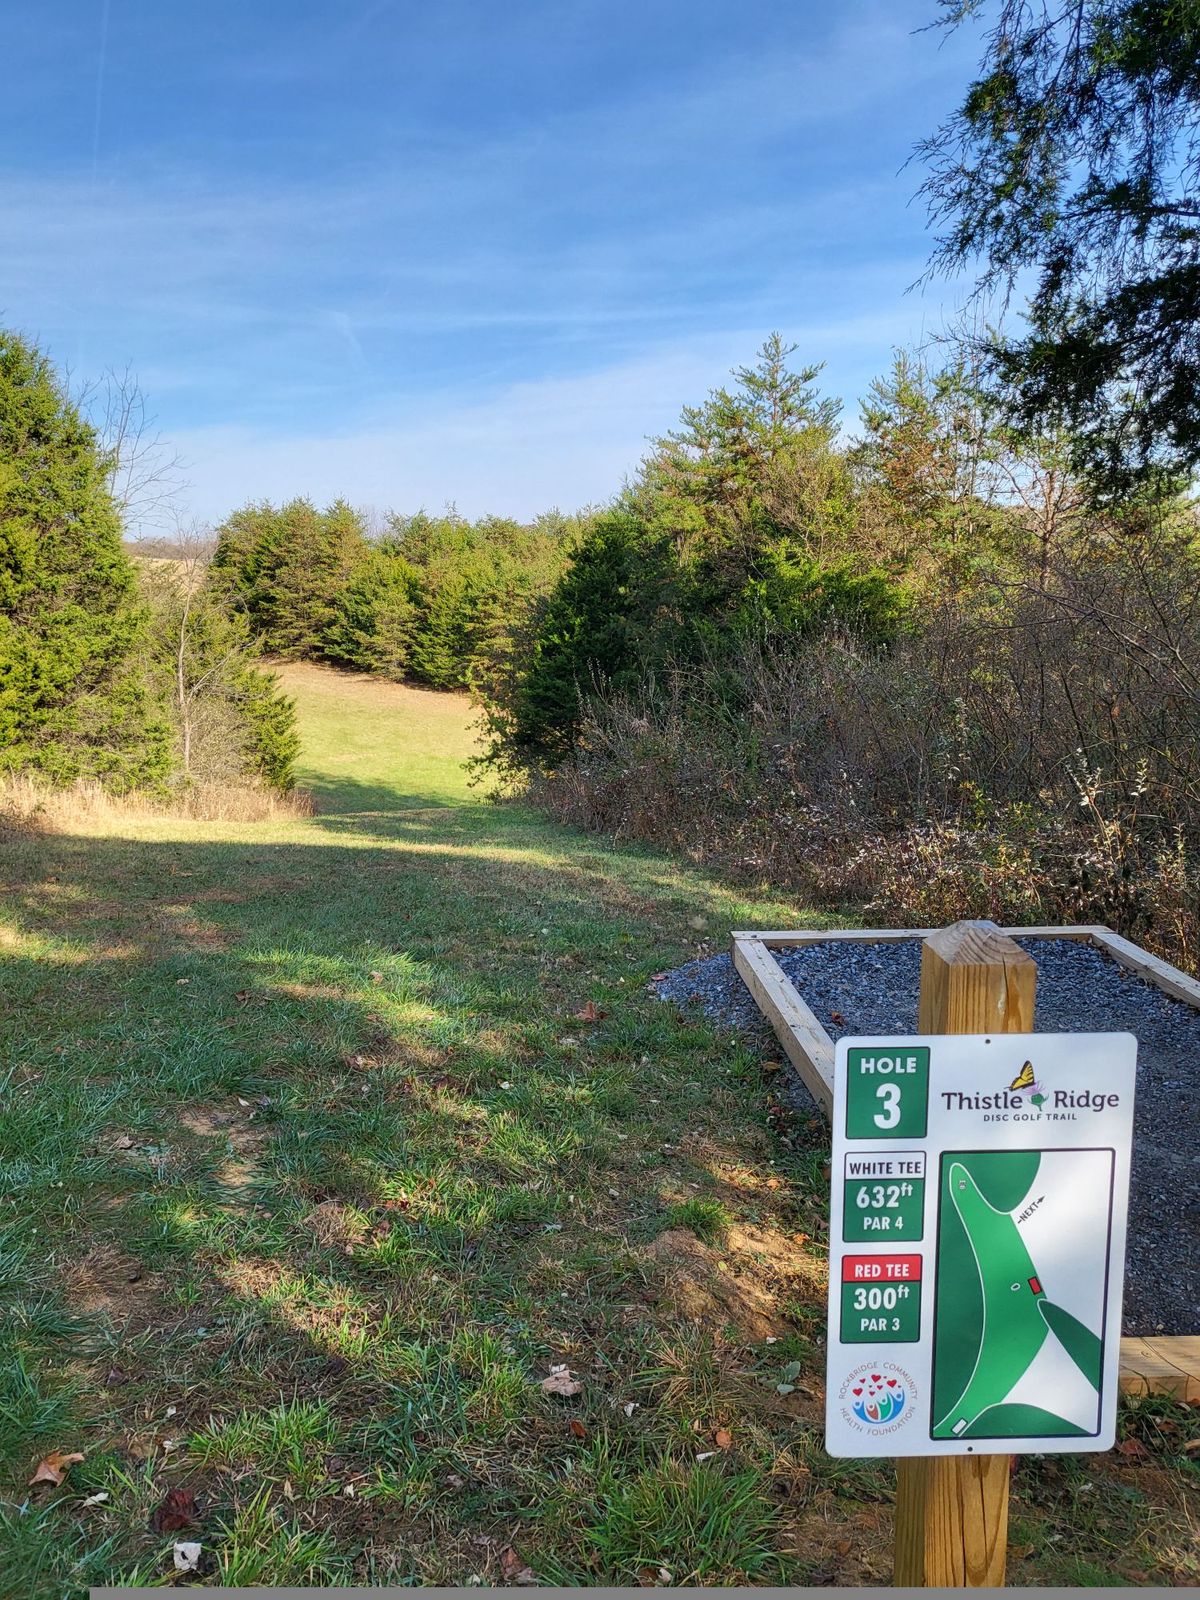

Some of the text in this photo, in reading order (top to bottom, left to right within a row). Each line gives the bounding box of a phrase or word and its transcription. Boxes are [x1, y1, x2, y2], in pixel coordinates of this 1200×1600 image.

[860, 1057, 917, 1074] HOLE
[873, 1082, 902, 1130] 3
[941, 1090, 1120, 1112] Thistle Ridge
[983, 1112, 1078, 1122] DISC GOLF TRAIL
[849, 1161, 922, 1175] WHITE TEE
[1019, 1201, 1040, 1223] NEXT
[863, 1216, 904, 1230] PAR 4
[854, 1263, 910, 1278] RED TEE
[860, 1317, 900, 1332] PAR 3
[838, 1361, 918, 1400] ROCKBRIDGE COMMUNITY
[840, 1406, 916, 1437] HEALTH FOUNDATION
